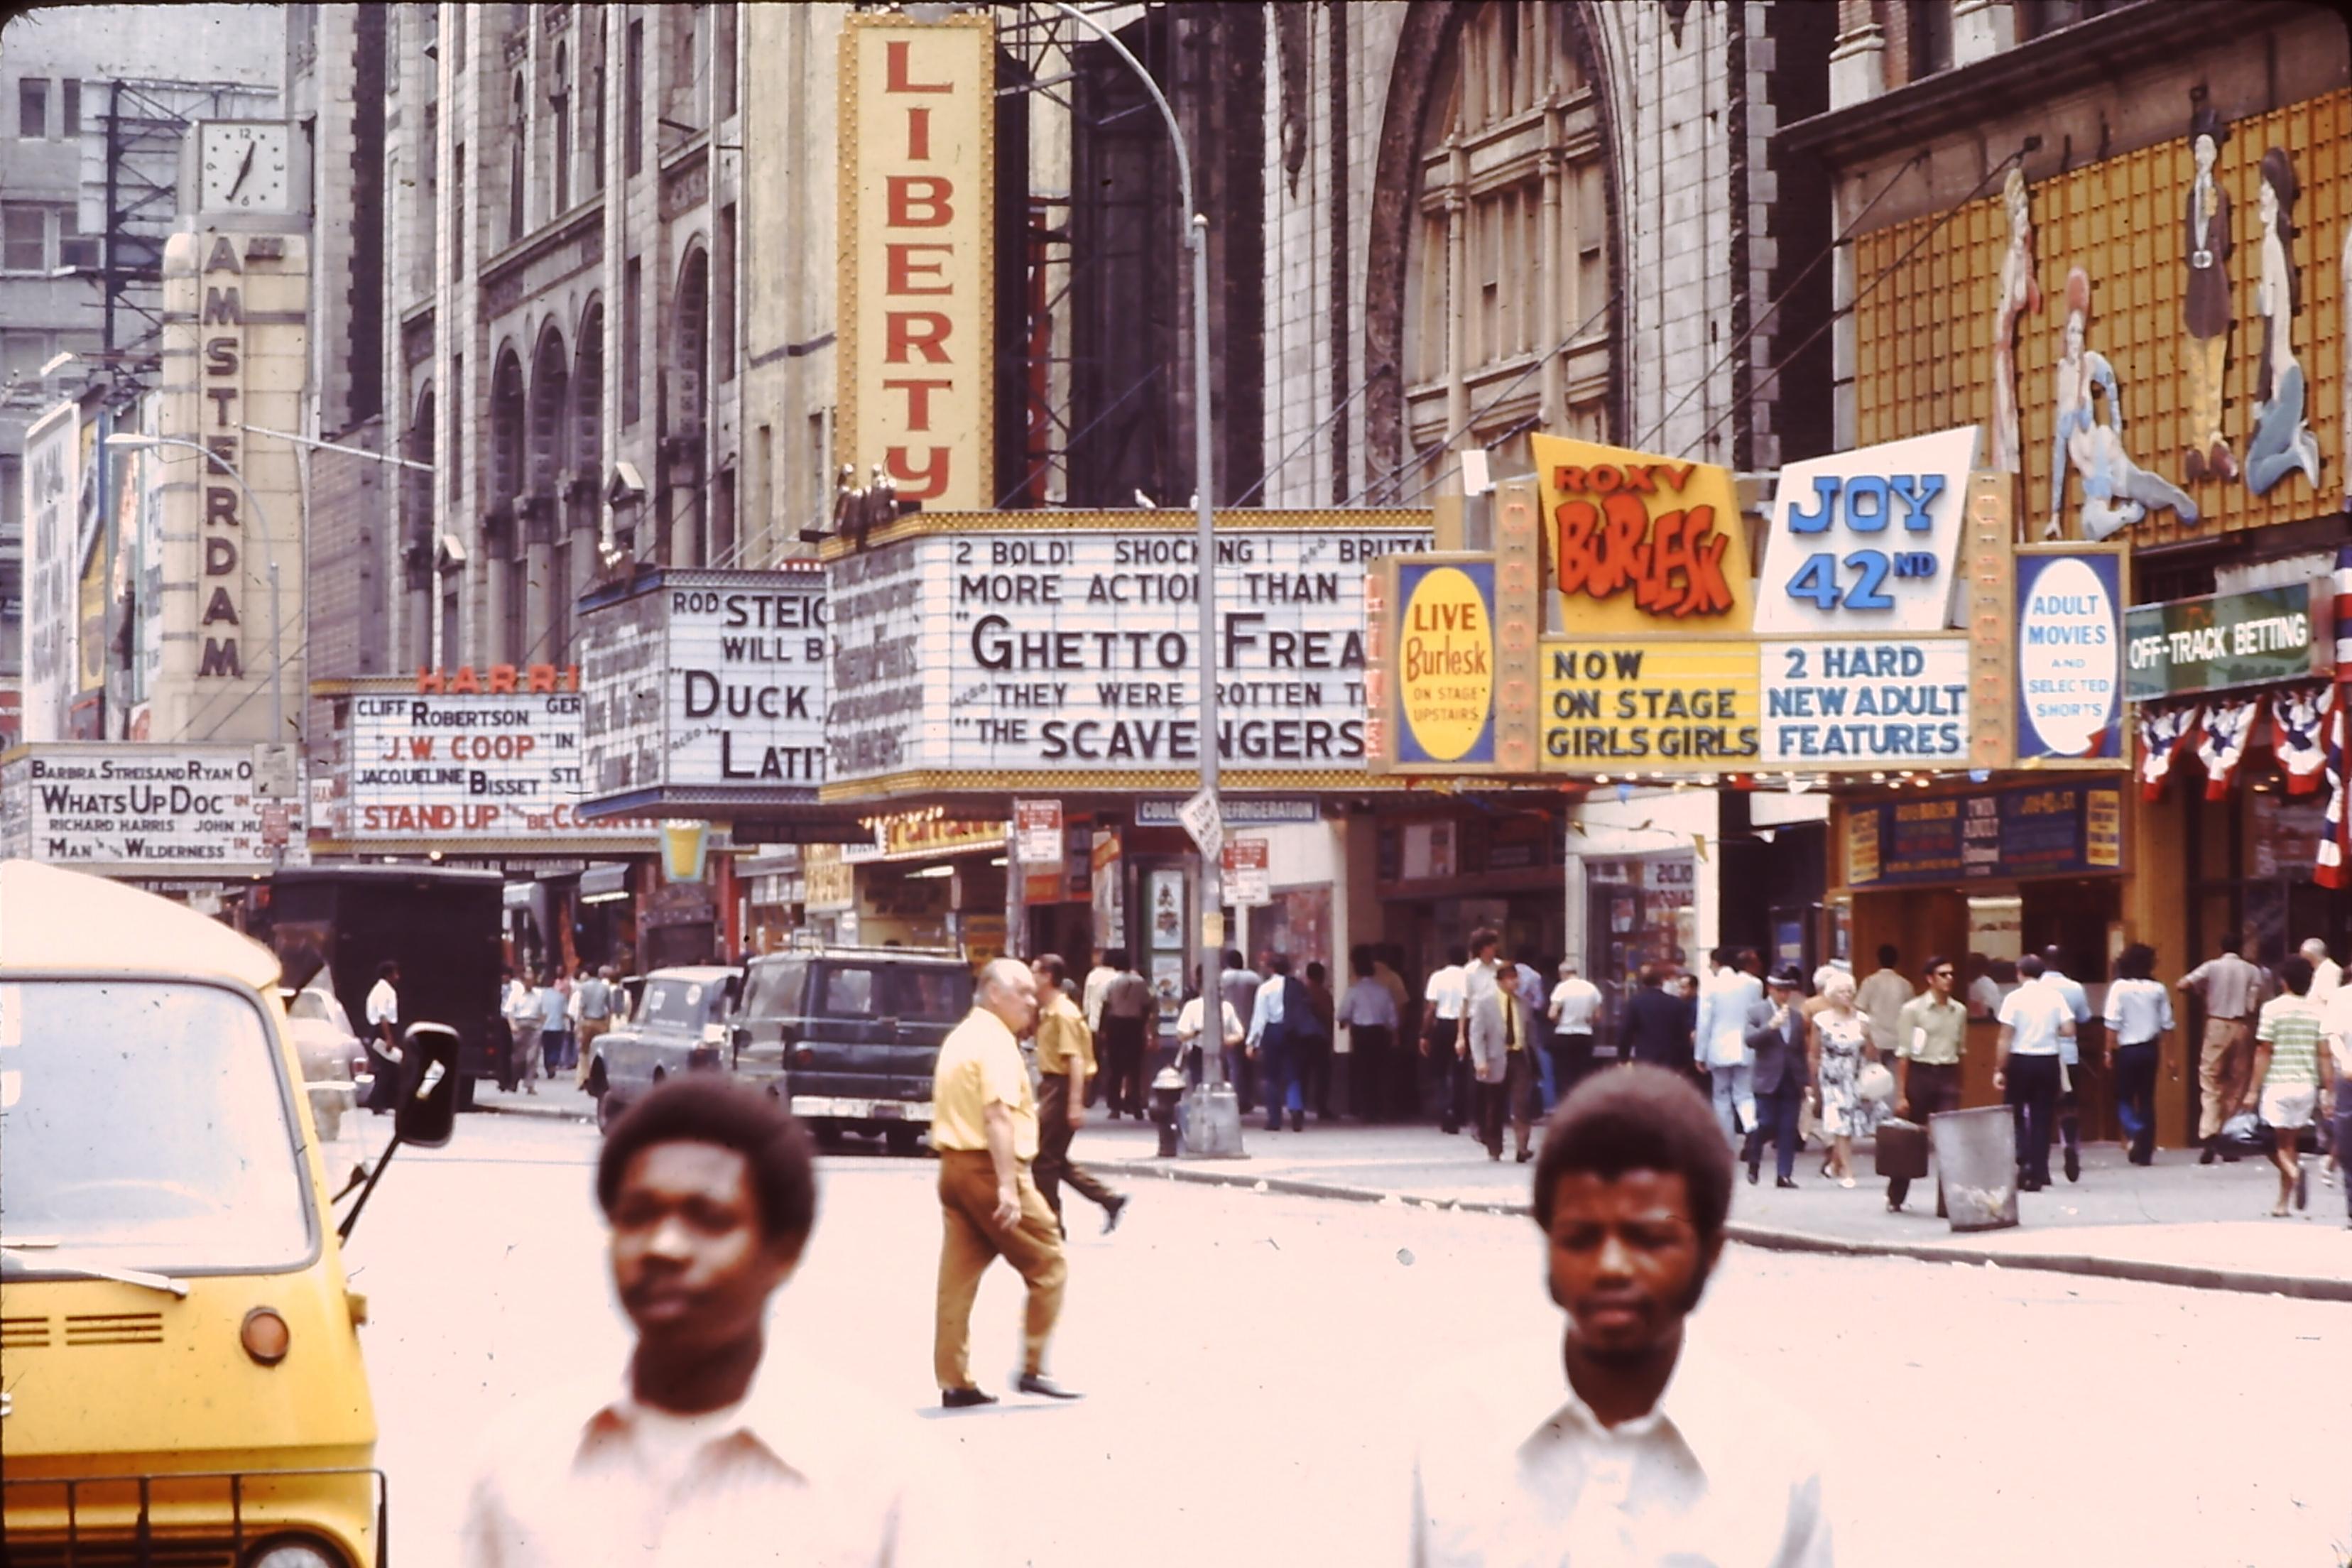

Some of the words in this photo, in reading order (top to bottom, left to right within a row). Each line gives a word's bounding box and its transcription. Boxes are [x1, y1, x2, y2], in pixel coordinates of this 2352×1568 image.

[240, 128, 251, 139] 12
[199, 236, 243, 679] AMSTERDAM
[1553, 464, 1698, 495] ROXY
[1788, 473, 1947, 534] JOY
[956, 541, 972, 565] 2
[993, 540, 1073, 565] BOLD!
[1555, 493, 1735, 617] BURLESK
[959, 575, 1062, 604] MORE
[1244, 573, 1337, 603] THAN
[673, 592, 719, 614] ROD
[2032, 595, 2098, 615] ADULT
[1414, 604, 1476, 631] LIVE
[2028, 625, 2106, 645] MOVIES
[2130, 626, 2227, 669] OFF-TRACK
[2233, 613, 2307, 655] BETTING
[723, 636, 792, 662] WILL
[1407, 634, 1487, 682] Burlesk
[1785, 647, 1807, 679] 2
[1822, 646, 1925, 678] HARD
[1553, 650, 1645, 680] NOW
[2052, 658, 2086, 668] AND
[996, 682, 1067, 708] THEY
[1096, 682, 1184, 707] WERE
[1414, 687, 1431, 700] ON
[1439, 687, 1477, 700] STAGE
[2029, 679, 2109, 693] SELECTED
[357, 699, 408, 717] CLIFF
[412, 702, 529, 726] ROBERTSON
[1553, 690, 1601, 719] ON
[1617, 689, 1736, 719] STAGE
[1768, 687, 1849, 717] NEW
[1853, 685, 1966, 717] ADULT
[2036, 703, 2102, 717] SHORTS
[1414, 708, 1479, 722] UPSTAIRS
[555, 733, 574, 748] IN
[1041, 719, 1365, 759] SCAVENGERS
[1547, 727, 1649, 758] GIRLS
[1657, 726, 1760, 758] GIRLS
[1778, 724, 1961, 756] FEATURES
[31, 760, 97, 779] BARBRA
[100, 760, 185, 780] STREISAND
[187, 761, 232, 779] RYAN
[356, 768, 464, 785] JACQUELINE
[469, 770, 540, 795] BISSET
[130, 785, 167, 814] UP
[234, 795, 249, 807] IN
[49, 819, 114, 832] RICHARD
[120, 820, 174, 832] HARRIS
[194, 820, 234, 832] JOHN
[364, 805, 457, 830] STAND
[463, 805, 500, 830] UP
[527, 815, 550, 830] BE
[234, 837, 249, 849] IN
